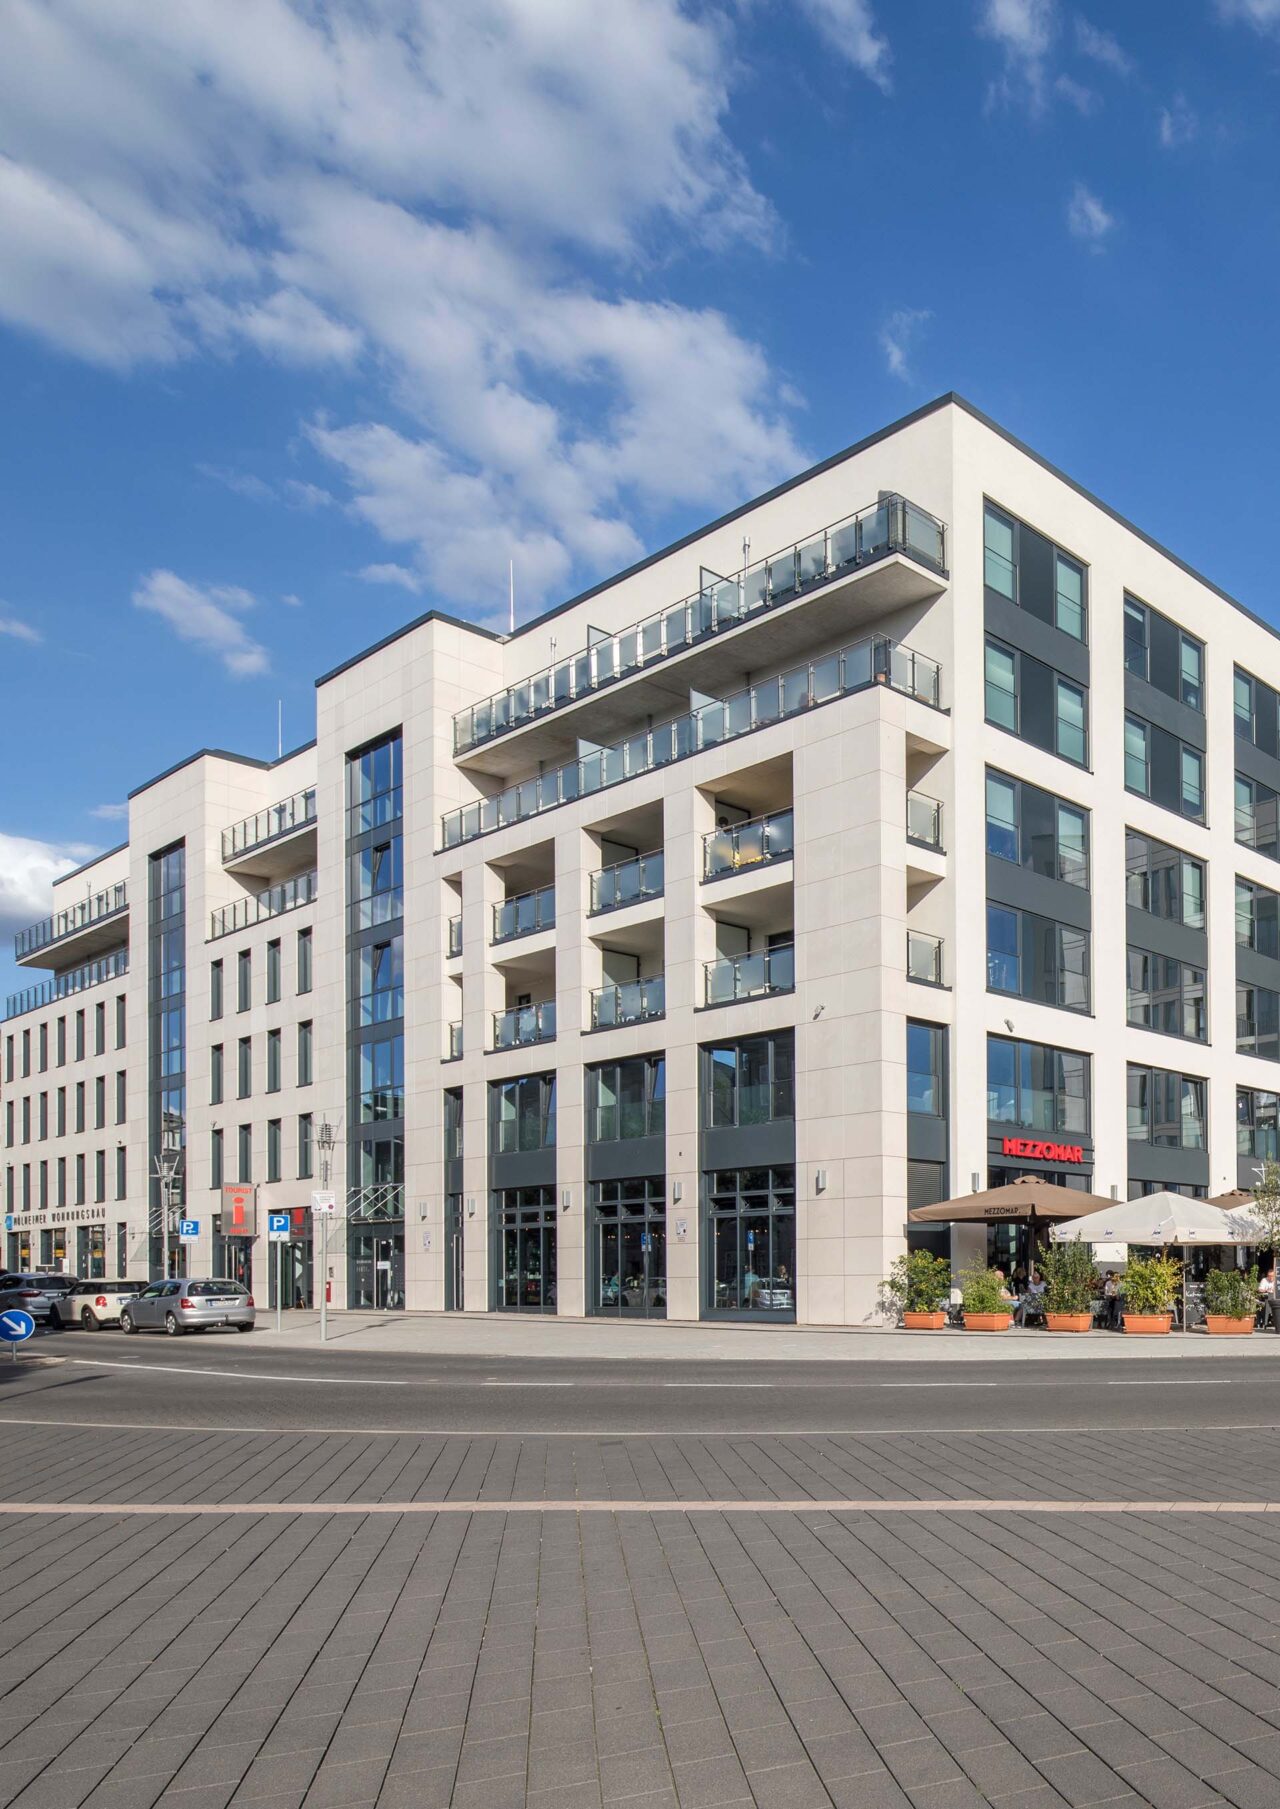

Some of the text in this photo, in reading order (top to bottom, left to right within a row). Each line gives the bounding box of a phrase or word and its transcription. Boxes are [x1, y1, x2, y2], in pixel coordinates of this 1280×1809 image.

[1003, 1136, 1082, 1164] MEZZOMAR
[52, 1208, 105, 1222] WOHNUNGSBAU
[273, 1217, 285, 1230] P
